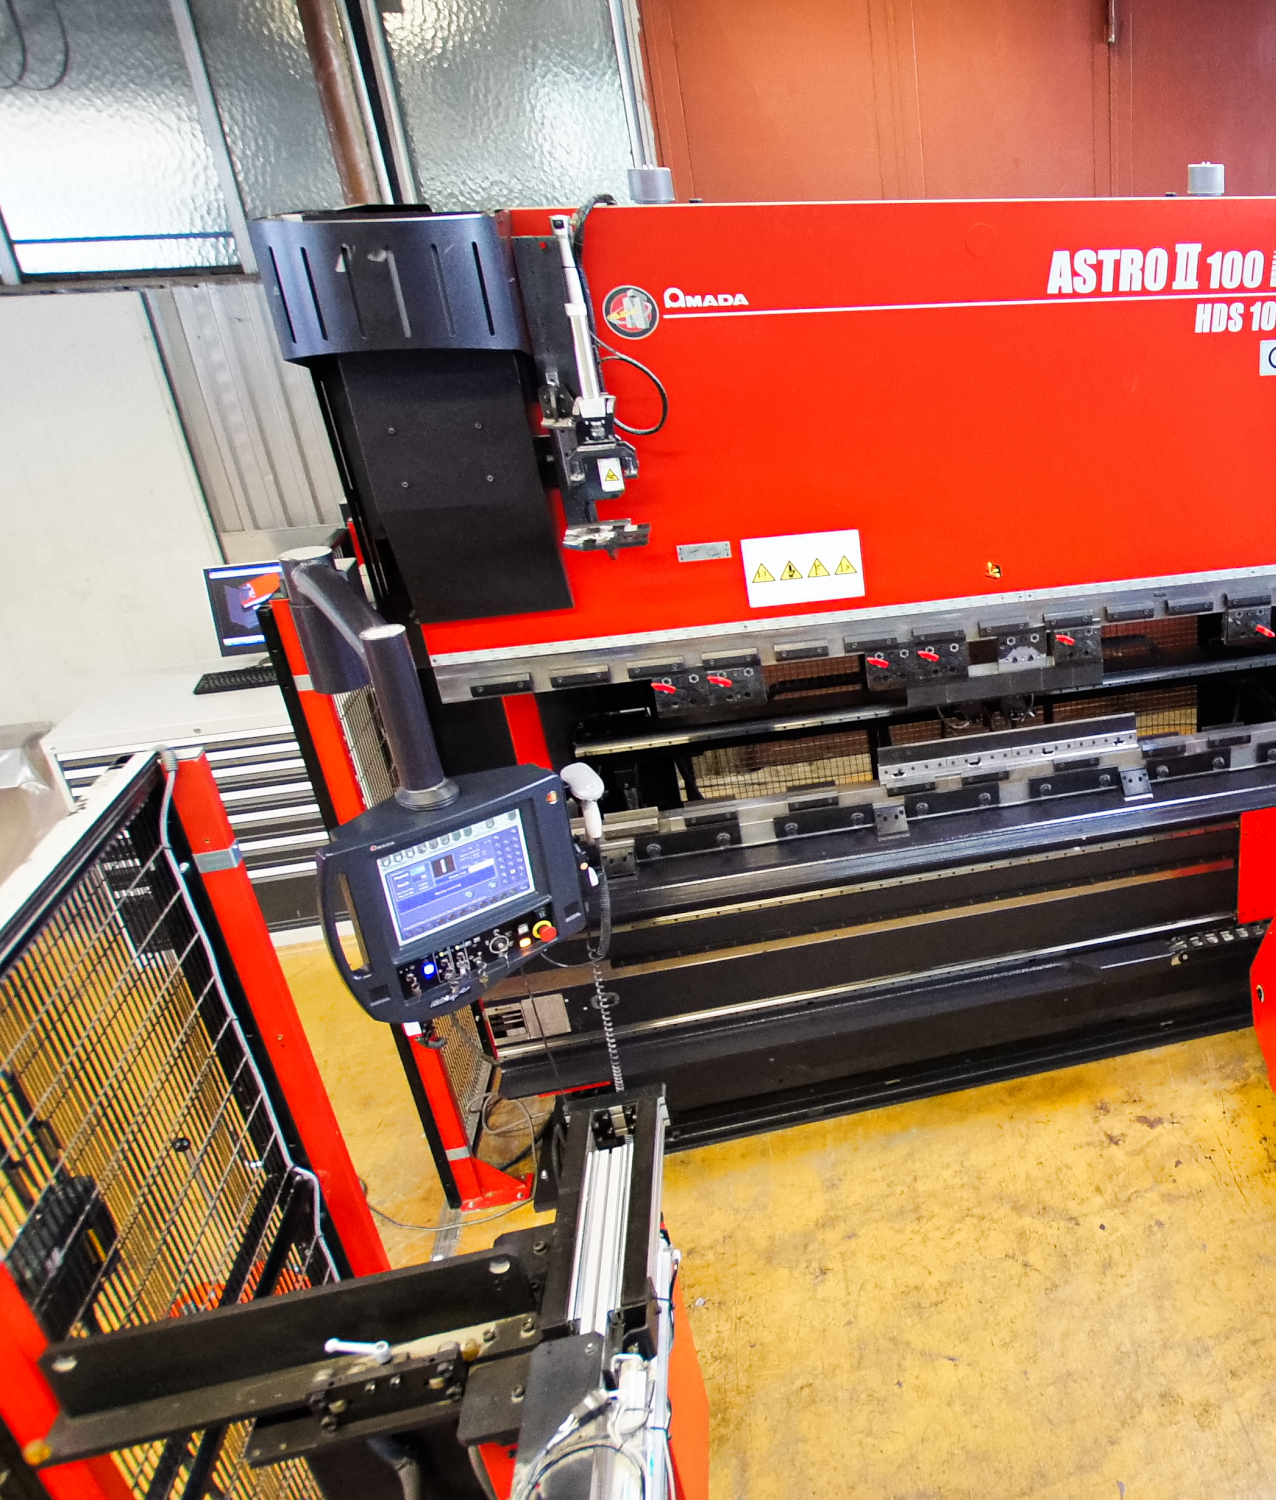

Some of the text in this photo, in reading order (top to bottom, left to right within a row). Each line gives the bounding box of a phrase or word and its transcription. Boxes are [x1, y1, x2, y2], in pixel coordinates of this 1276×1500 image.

[1047, 247, 1169, 294] ASTRO
[1206, 250, 1265, 289] 100
[663, 287, 750, 309] AMADA
[1194, 302, 1245, 334] HDS
